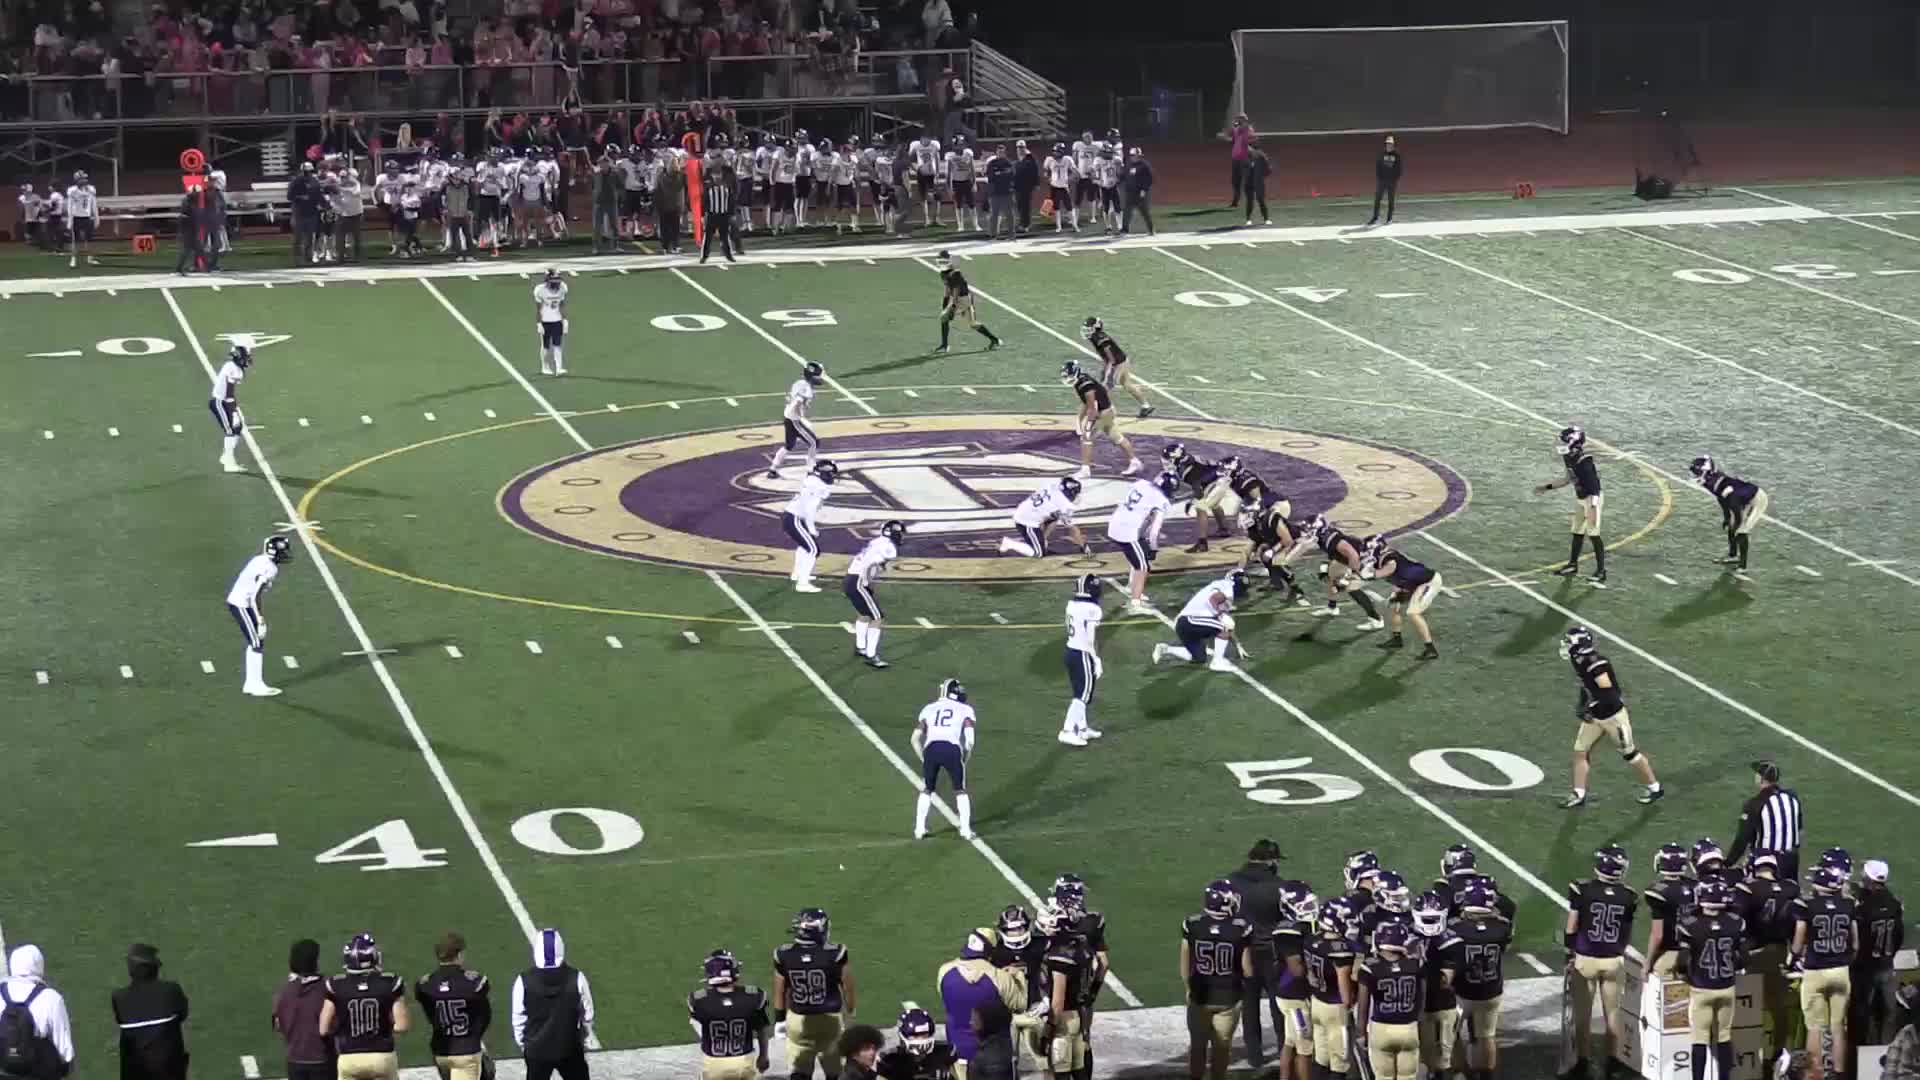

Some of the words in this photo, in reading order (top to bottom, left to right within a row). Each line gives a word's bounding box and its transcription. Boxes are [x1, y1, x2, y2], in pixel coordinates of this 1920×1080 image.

[650, 309, 839, 331] 50
[934, 708, 954, 727] 12
[1224, 748, 1545, 805] 50
[315, 808, 645, 872] 40
[1588, 903, 1625, 943] 35
[1812, 914, 1850, 953] 36
[1195, 939, 1235, 976] 50
[1465, 943, 1500, 984] 53
[1699, 937, 1734, 980] 43
[347, 998, 379, 1038] 10
[436, 999, 470, 1037] 15
